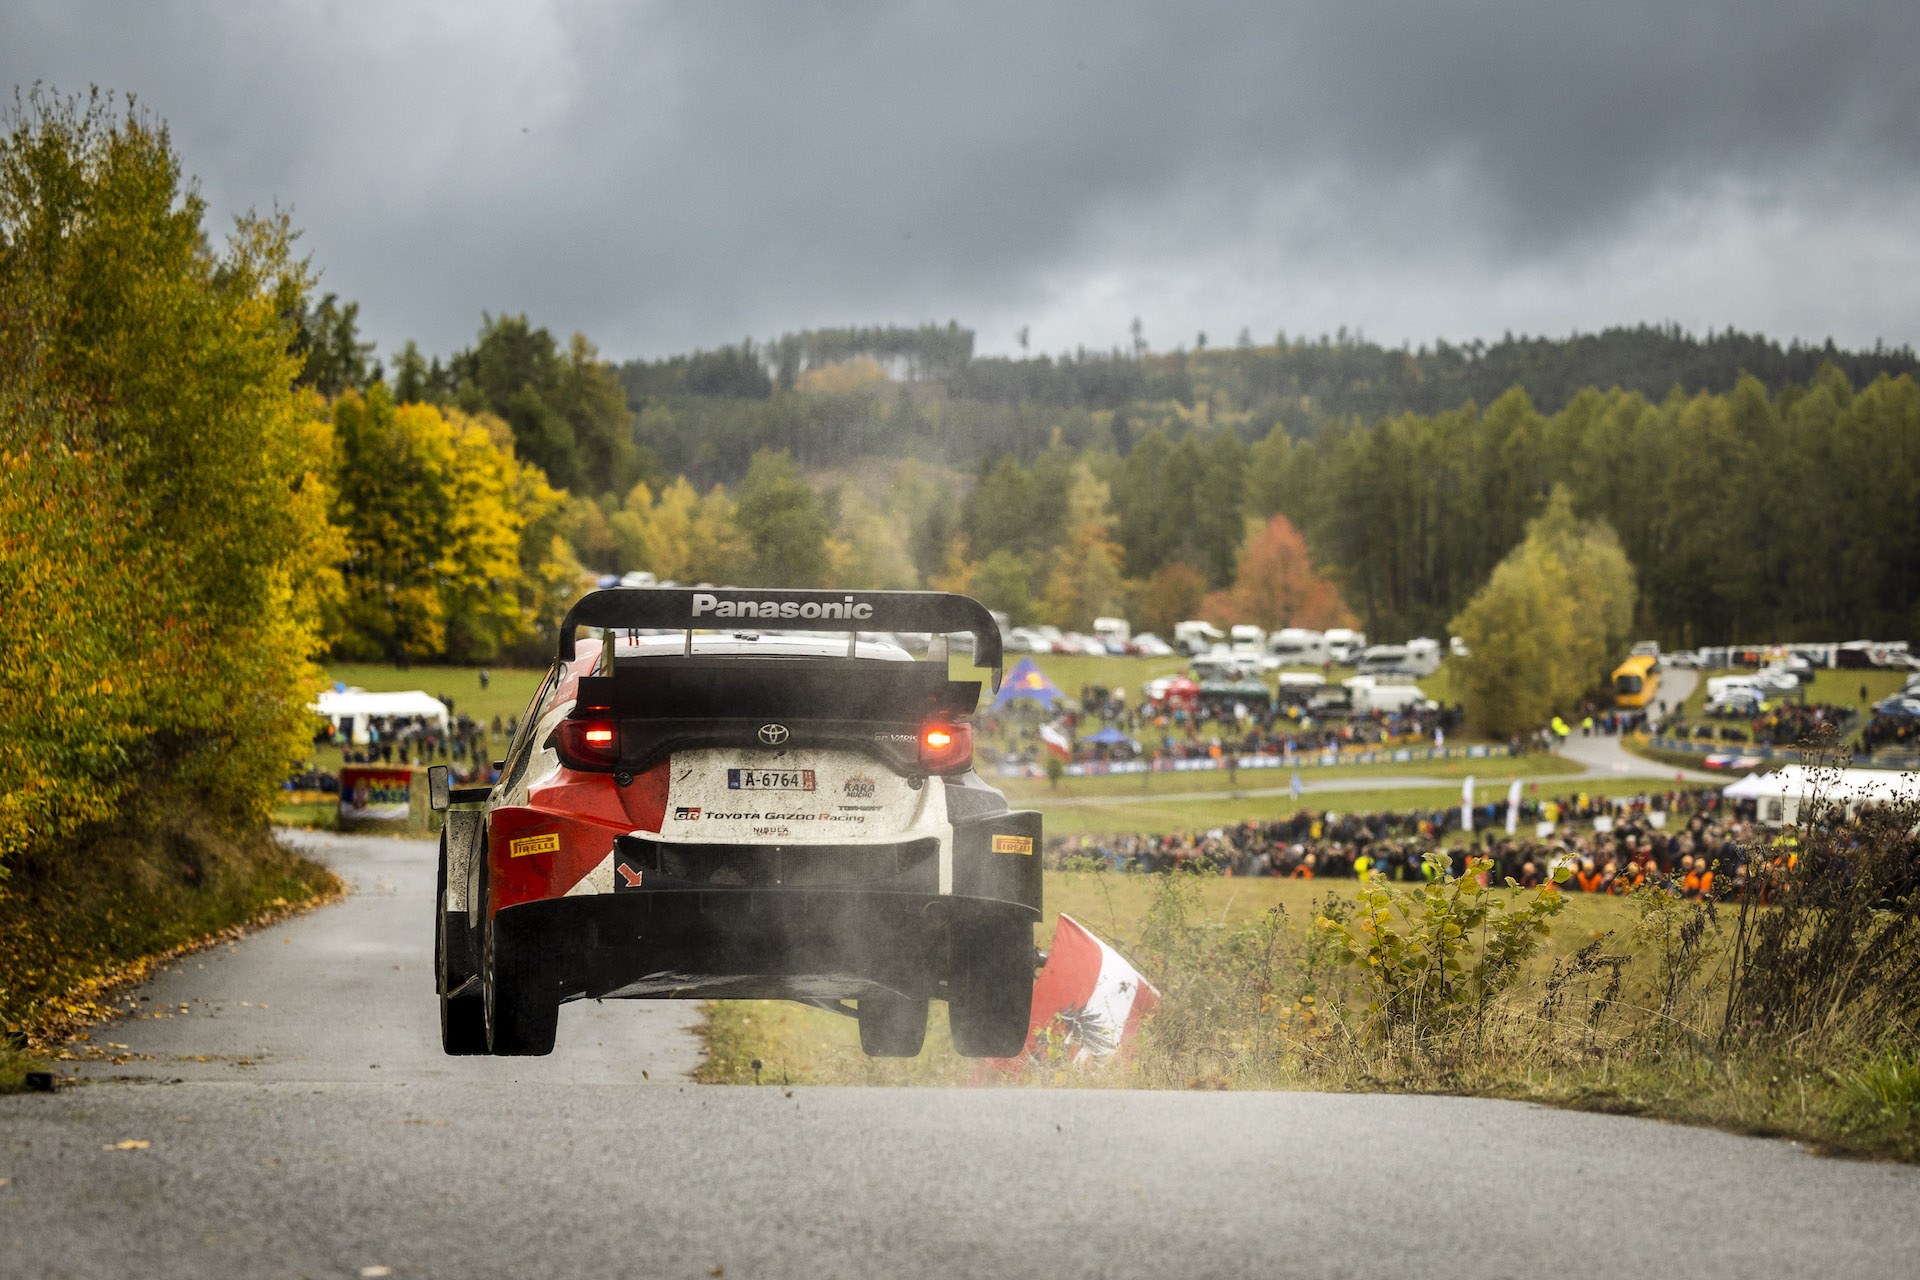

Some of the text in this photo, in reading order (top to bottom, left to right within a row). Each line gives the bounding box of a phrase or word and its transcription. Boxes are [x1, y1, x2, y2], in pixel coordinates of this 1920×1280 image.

[691, 593, 874, 620] Panasonic
[745, 772, 799, 787] A-6764
[843, 783, 876, 792] KARA
[705, 811, 760, 820] TOYOTA
[764, 812, 815, 821] GAZOO
[818, 813, 865, 824] Racing
[513, 837, 555, 854] PIRELLI
[996, 838, 1031, 852] PIRELLI
